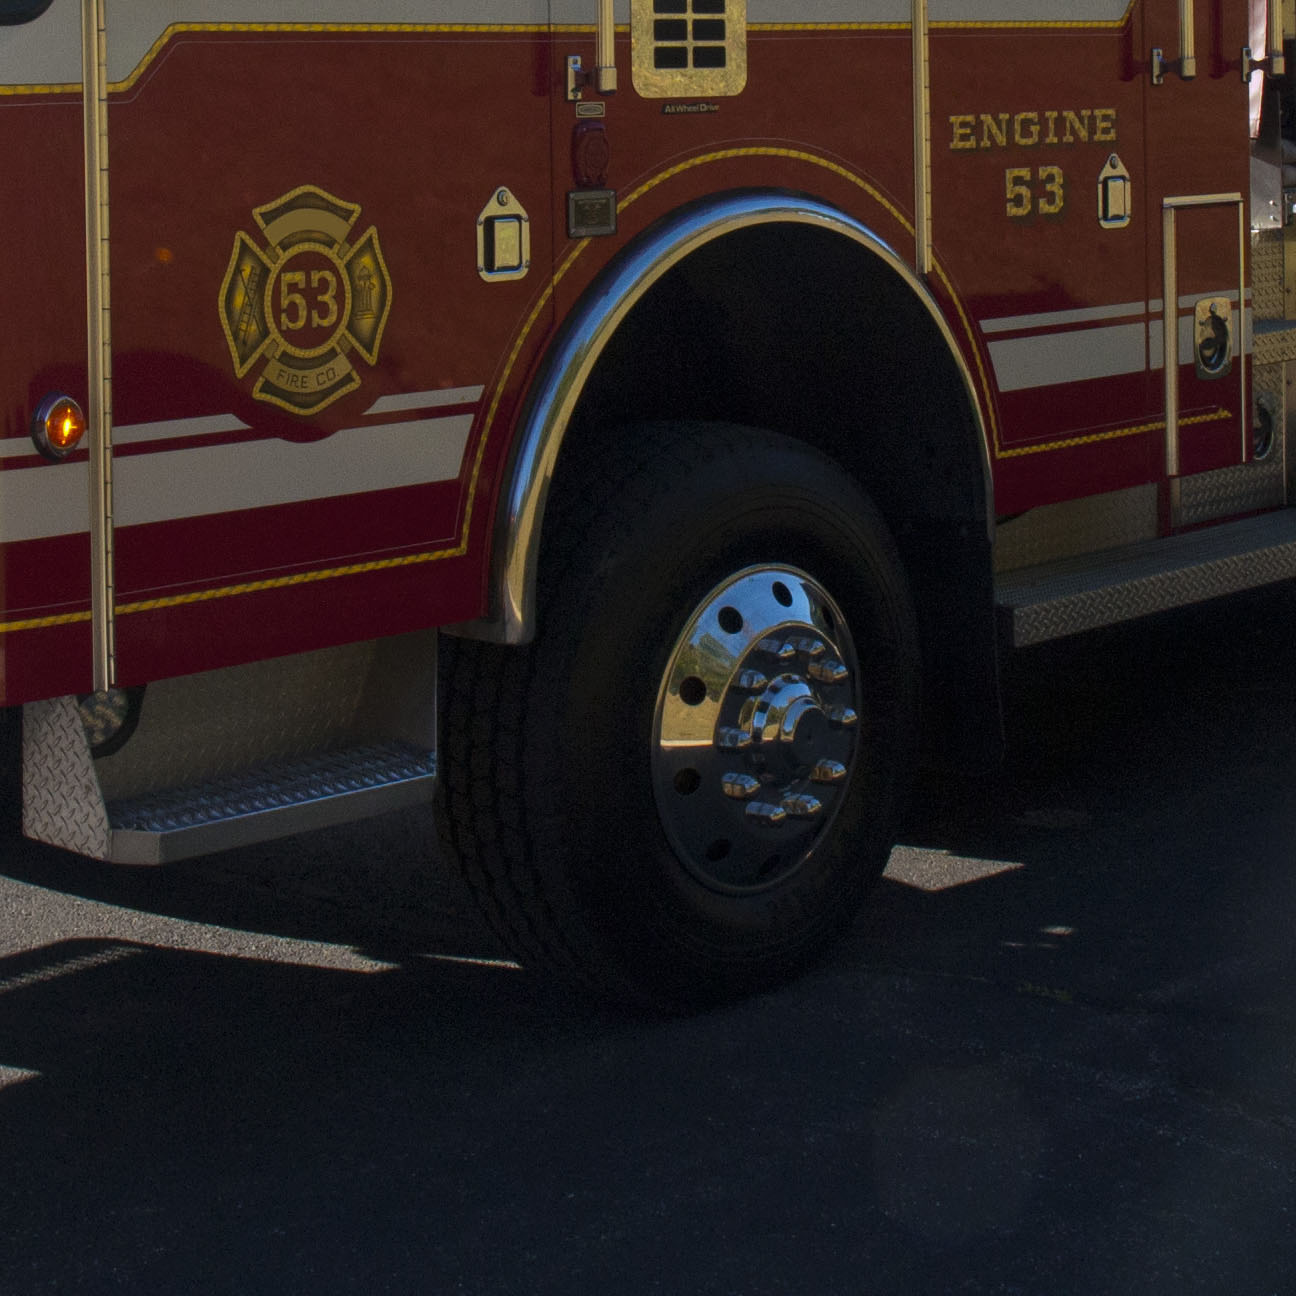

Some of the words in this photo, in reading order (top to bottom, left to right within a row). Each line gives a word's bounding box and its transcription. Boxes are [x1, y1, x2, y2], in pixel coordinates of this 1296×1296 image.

[676, 104, 700, 113] Wheel
[700, 103, 719, 112] Drive
[949, 109, 1117, 149] ENGINE
[1006, 166, 1064, 216] 53
[281, 270, 338, 329] 53
[276, 368, 308, 389] FIRE
